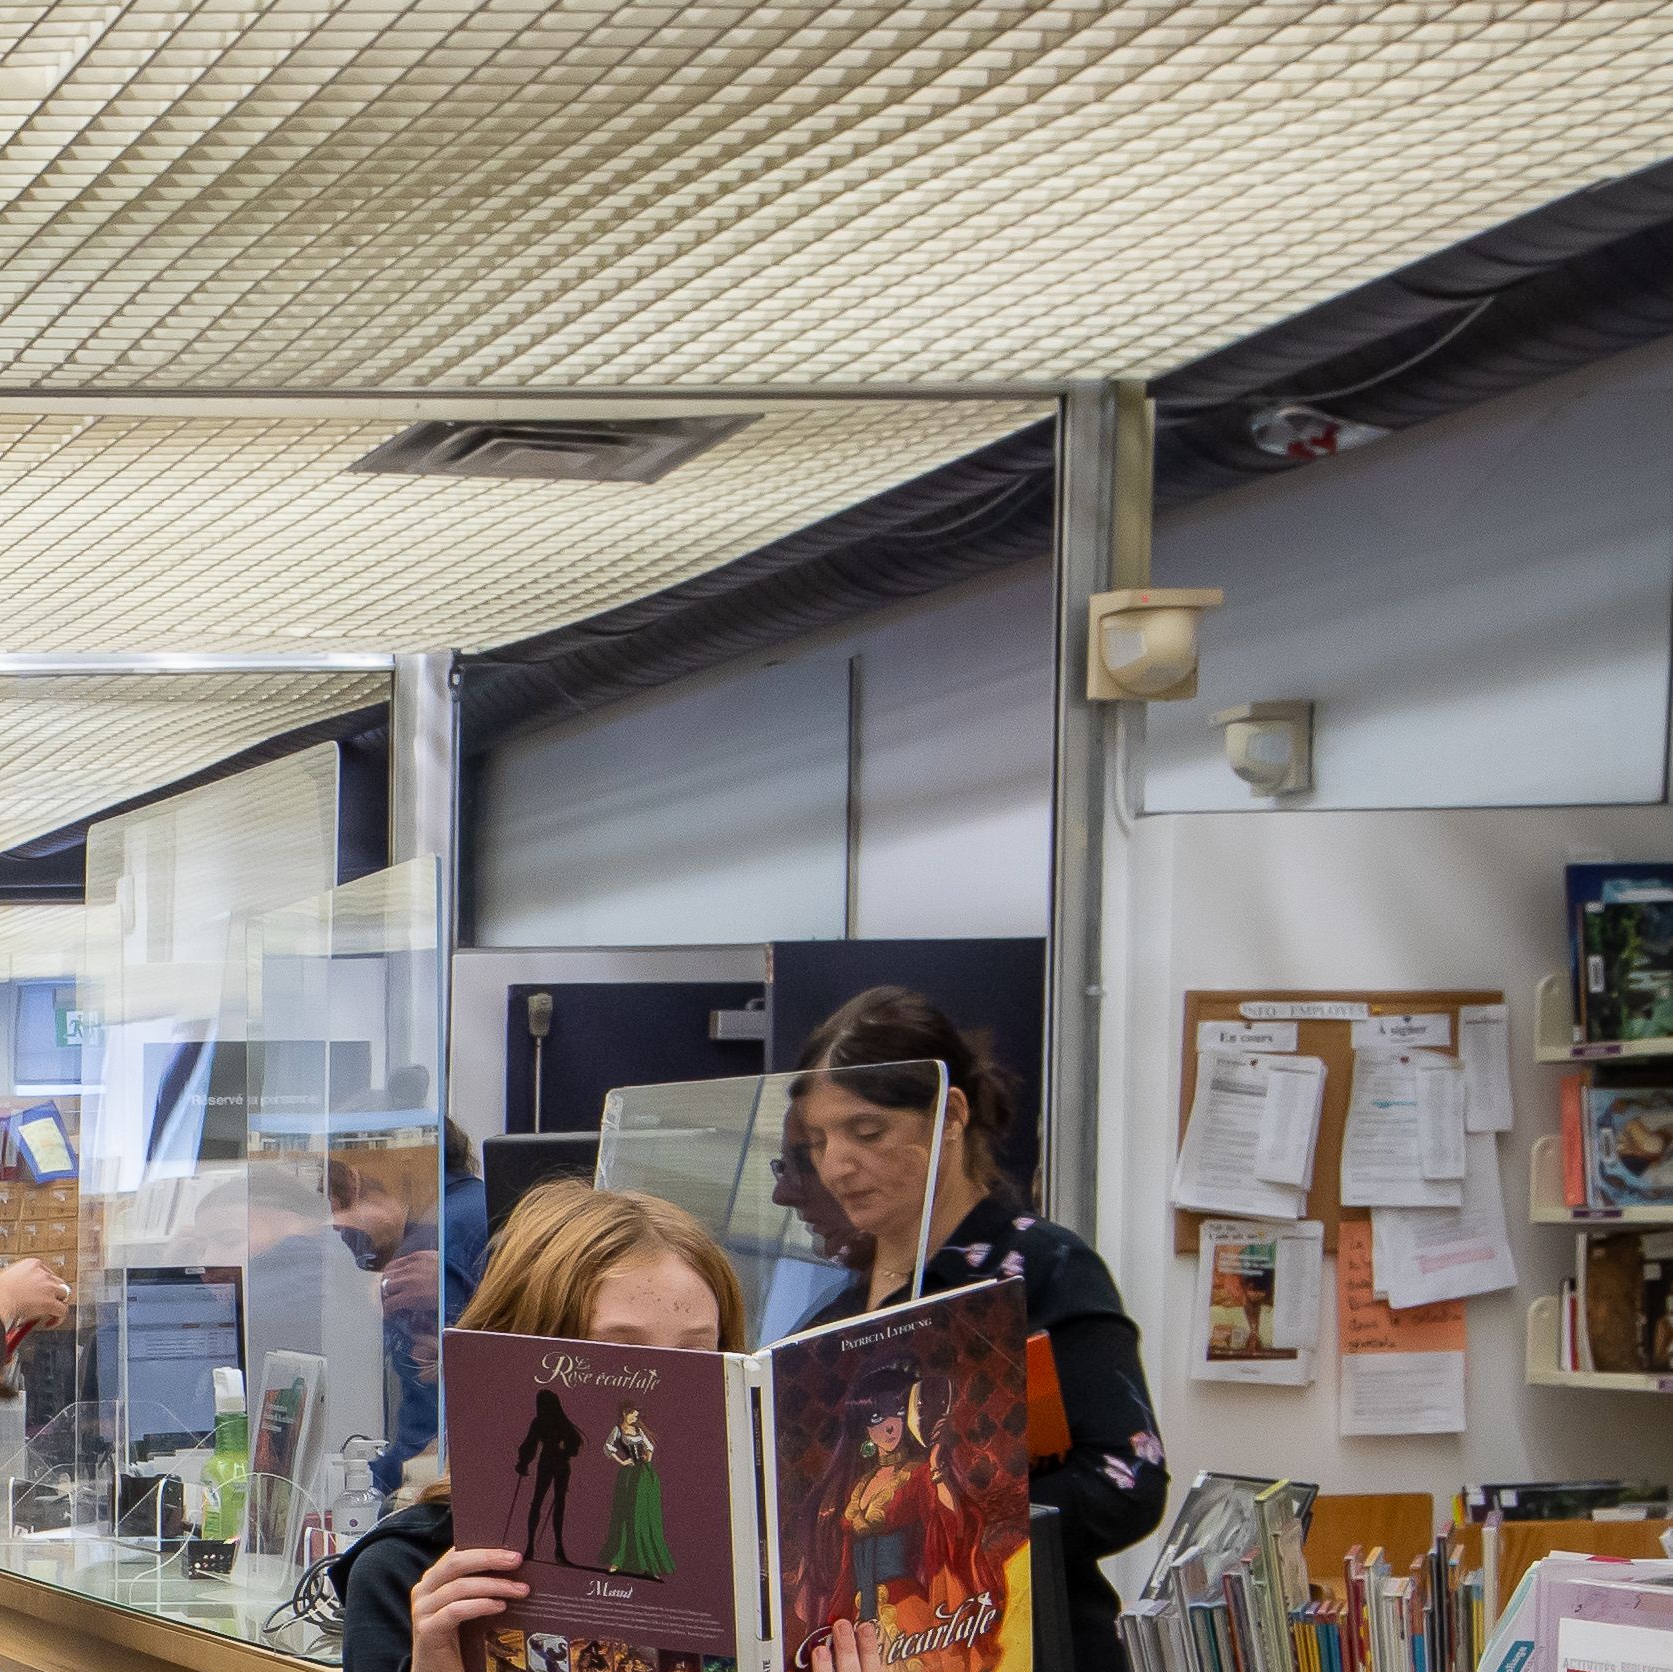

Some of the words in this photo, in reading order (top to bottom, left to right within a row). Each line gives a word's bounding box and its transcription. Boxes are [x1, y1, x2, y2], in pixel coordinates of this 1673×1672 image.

[841, 1332, 885, 1352] PATRICIA
[532, 1349, 593, 1388] Rose
[595, 1362, 663, 1396] écarlate
[586, 1579, 635, 1601] Maud
[886, 1592, 997, 1668] écarlate
